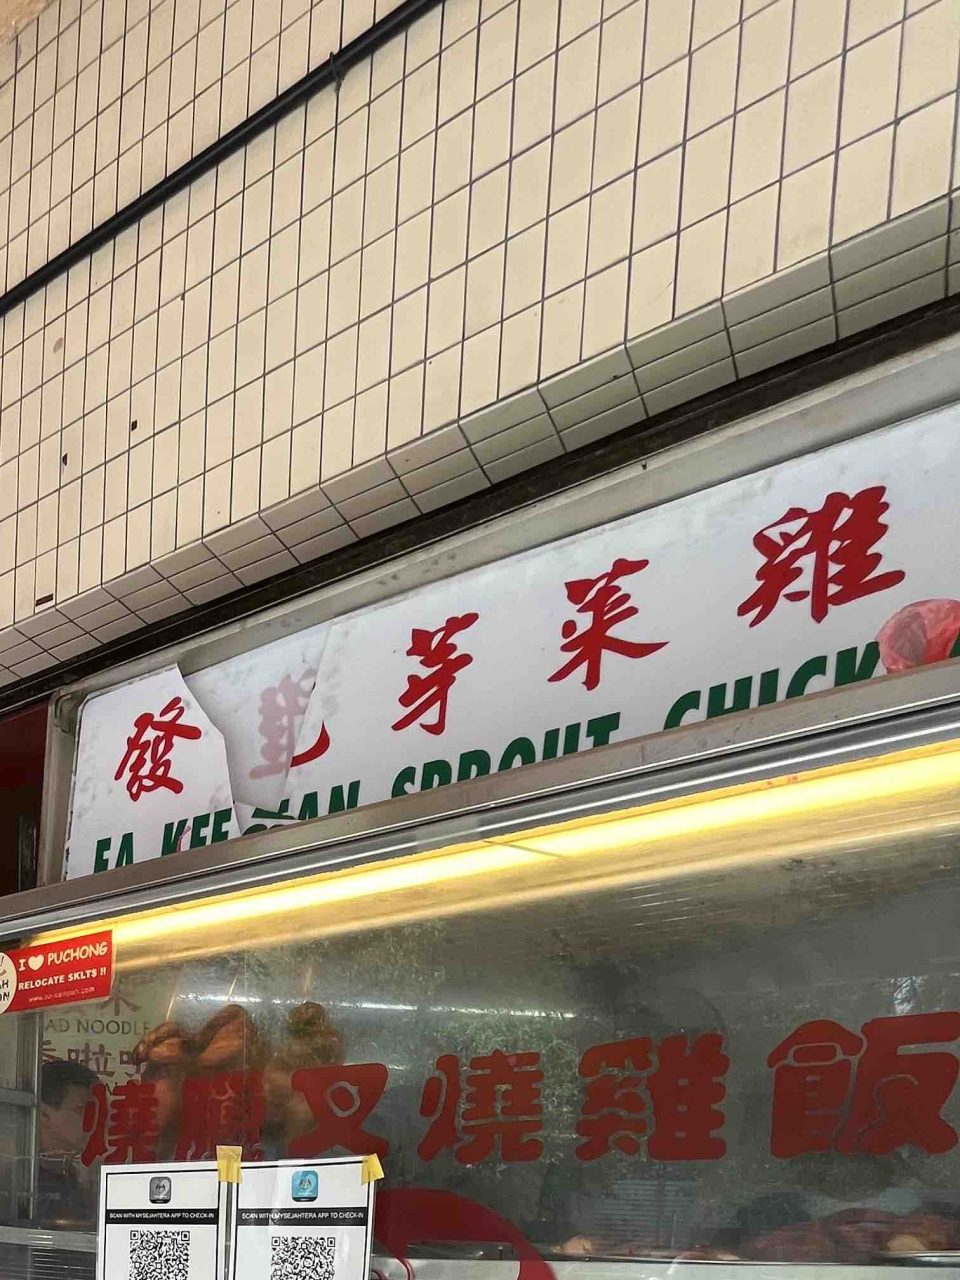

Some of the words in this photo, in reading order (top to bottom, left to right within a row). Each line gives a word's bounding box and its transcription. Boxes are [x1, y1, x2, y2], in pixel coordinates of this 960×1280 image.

[663, 628, 960, 731] CHICK
[18, 959, 26, 972] I
[47, 941, 108, 966] PUCHONG
[18, 974, 66, 991] RELOCATE
